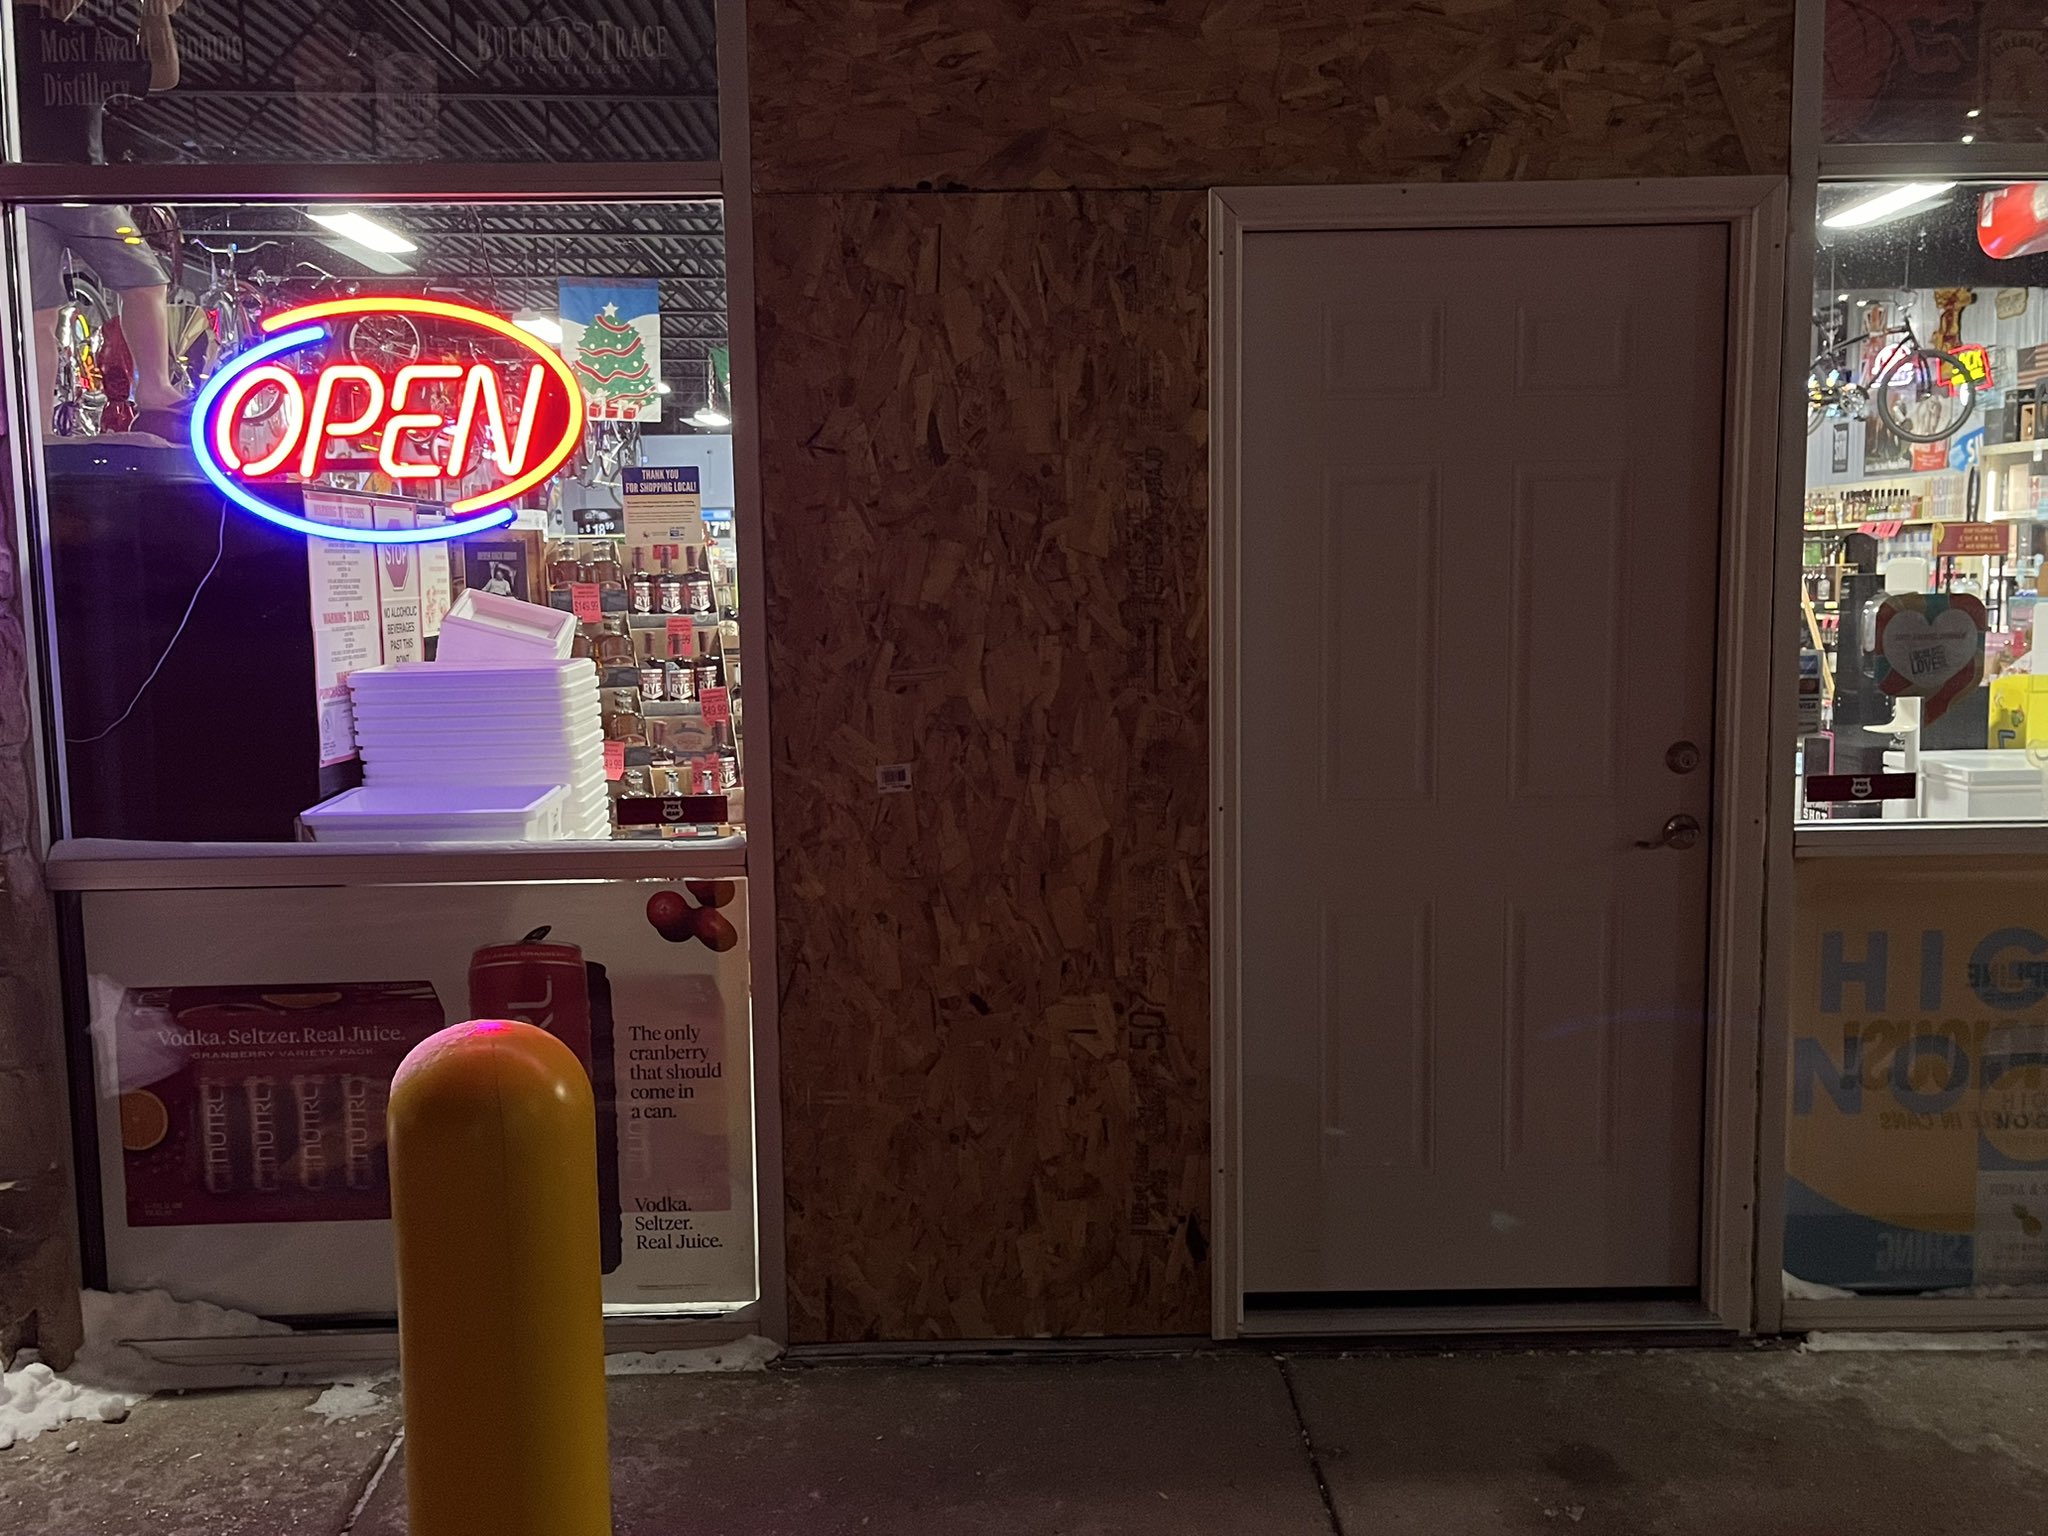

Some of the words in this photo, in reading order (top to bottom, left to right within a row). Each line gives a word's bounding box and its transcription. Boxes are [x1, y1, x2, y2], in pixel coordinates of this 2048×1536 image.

[39, 29, 87, 63] Most
[477, 20, 571, 62] BUFFALO
[597, 19, 669, 63] TRACE
[215, 363, 545, 478] OPEN
[641, 469, 665, 481] THANK
[665, 468, 679, 480] YOU
[625, 482, 639, 493] FOR
[639, 481, 673, 493] SHOPPING
[673, 480, 697, 493] LOCAL!
[386, 545, 408, 565] STOP
[662, 596, 680, 607] RYE
[691, 594, 710, 606] RYE
[391, 606, 418, 618] ALCOHOLIC
[387, 621, 416, 635] BEVERAGES
[390, 639, 403, 651] PAST
[403, 638, 414, 649] THIS
[643, 683, 661, 694] RYE
[671, 682, 690, 693] RYE
[156, 1028, 227, 1047] Vodka.
[229, 1026, 299, 1046] Seltzer.
[300, 1024, 345, 1044] Real
[348, 1023, 406, 1043] Juice.
[629, 1025, 662, 1042] The
[664, 1023, 701, 1043] only
[278, 1048, 336, 1059] VARIETY
[339, 1047, 374, 1057] PACK
[629, 1045, 709, 1063] cranberry
[629, 1063, 663, 1080] that
[666, 1062, 722, 1080] should
[630, 1086, 676, 1100] come
[677, 1083, 695, 1099] in
[631, 1107, 641, 1119] a
[643, 1105, 677, 1119] can.
[634, 1197, 692, 1212] Vodka.
[634, 1215, 694, 1232] Seltzer.
[636, 1234, 672, 1250] Real
[675, 1233, 724, 1250] Juice.
